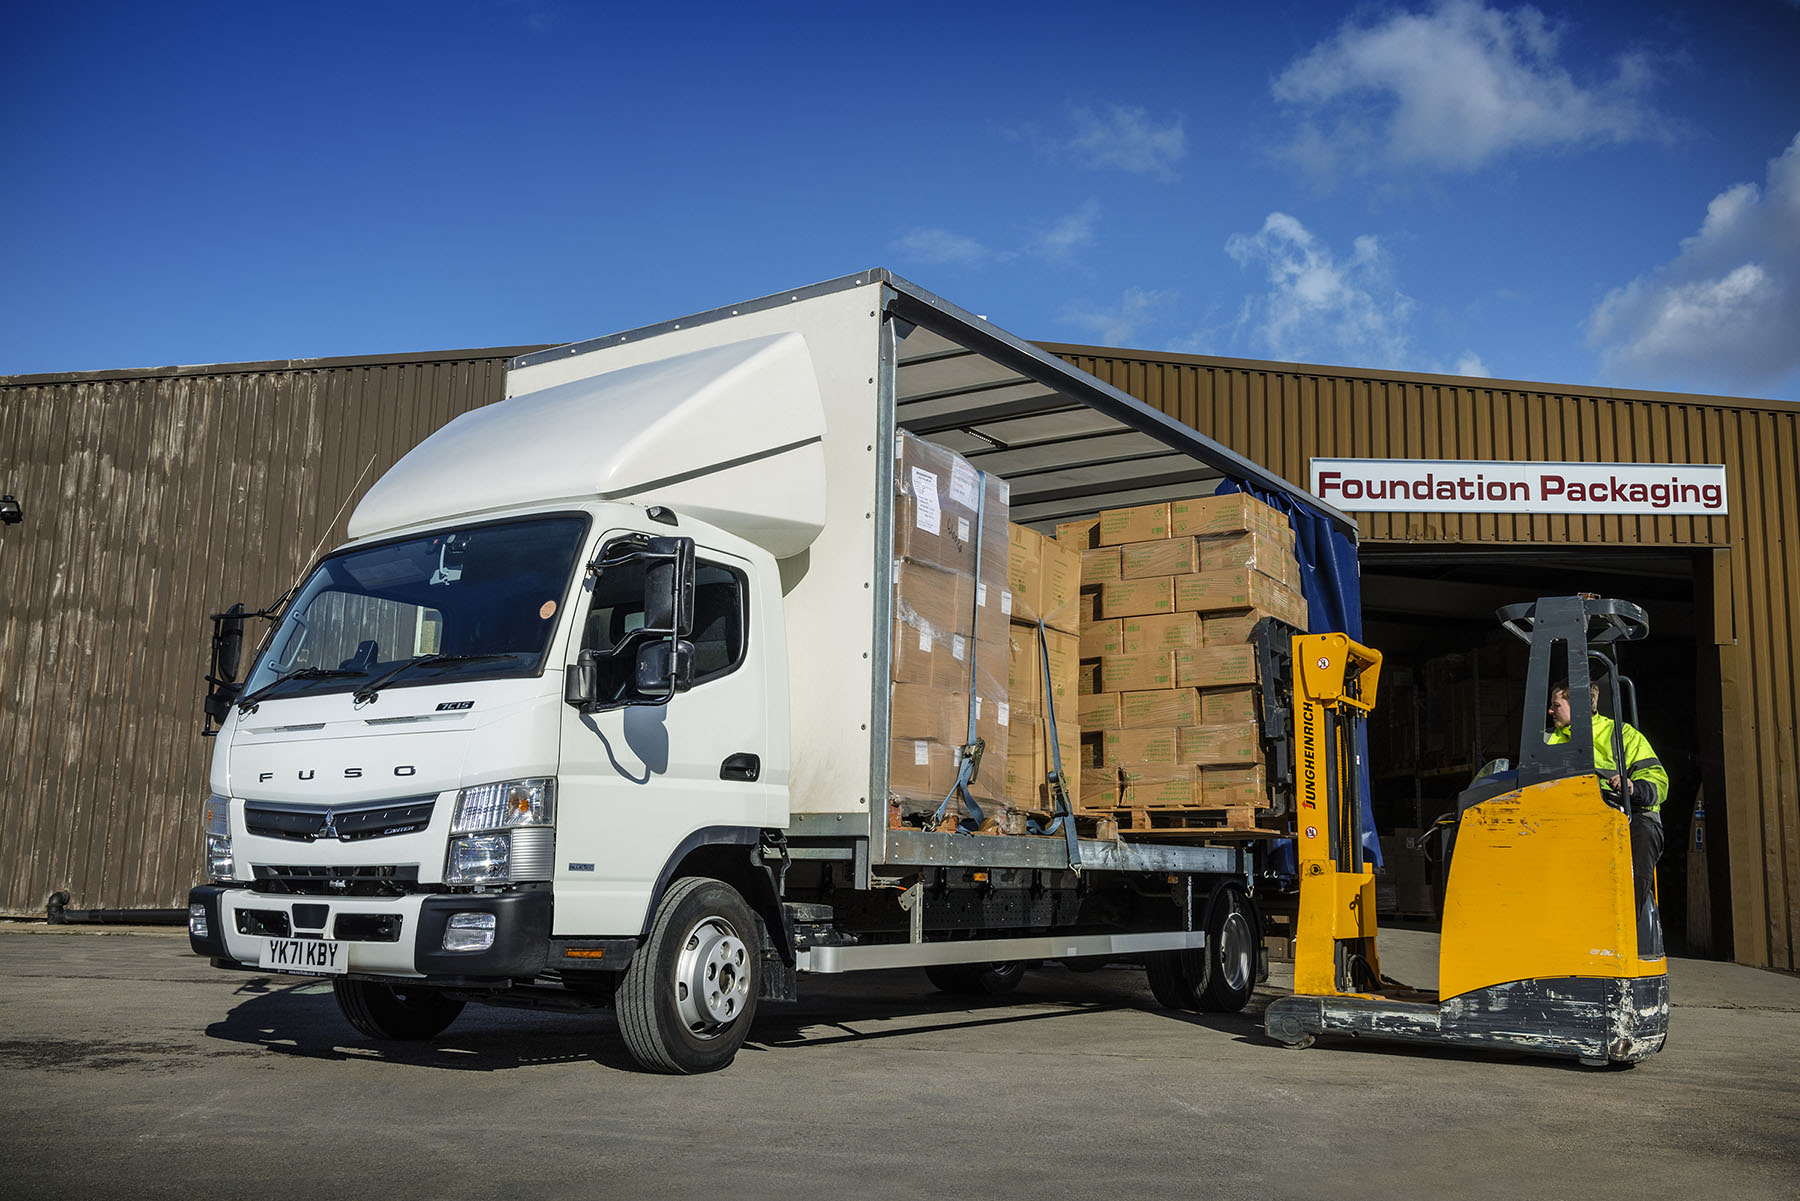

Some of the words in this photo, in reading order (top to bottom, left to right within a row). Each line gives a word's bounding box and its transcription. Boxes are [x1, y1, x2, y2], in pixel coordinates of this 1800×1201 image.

[1318, 471, 1530, 501] Foundation
[1540, 475, 1722, 509] Packaging
[441, 701, 471, 710] 7C15
[1303, 701, 1316, 810] JUNGHEINRICH
[259, 765, 416, 783] FUSO
[270, 940, 303, 965] YK71
[306, 942, 338, 967] KBY
